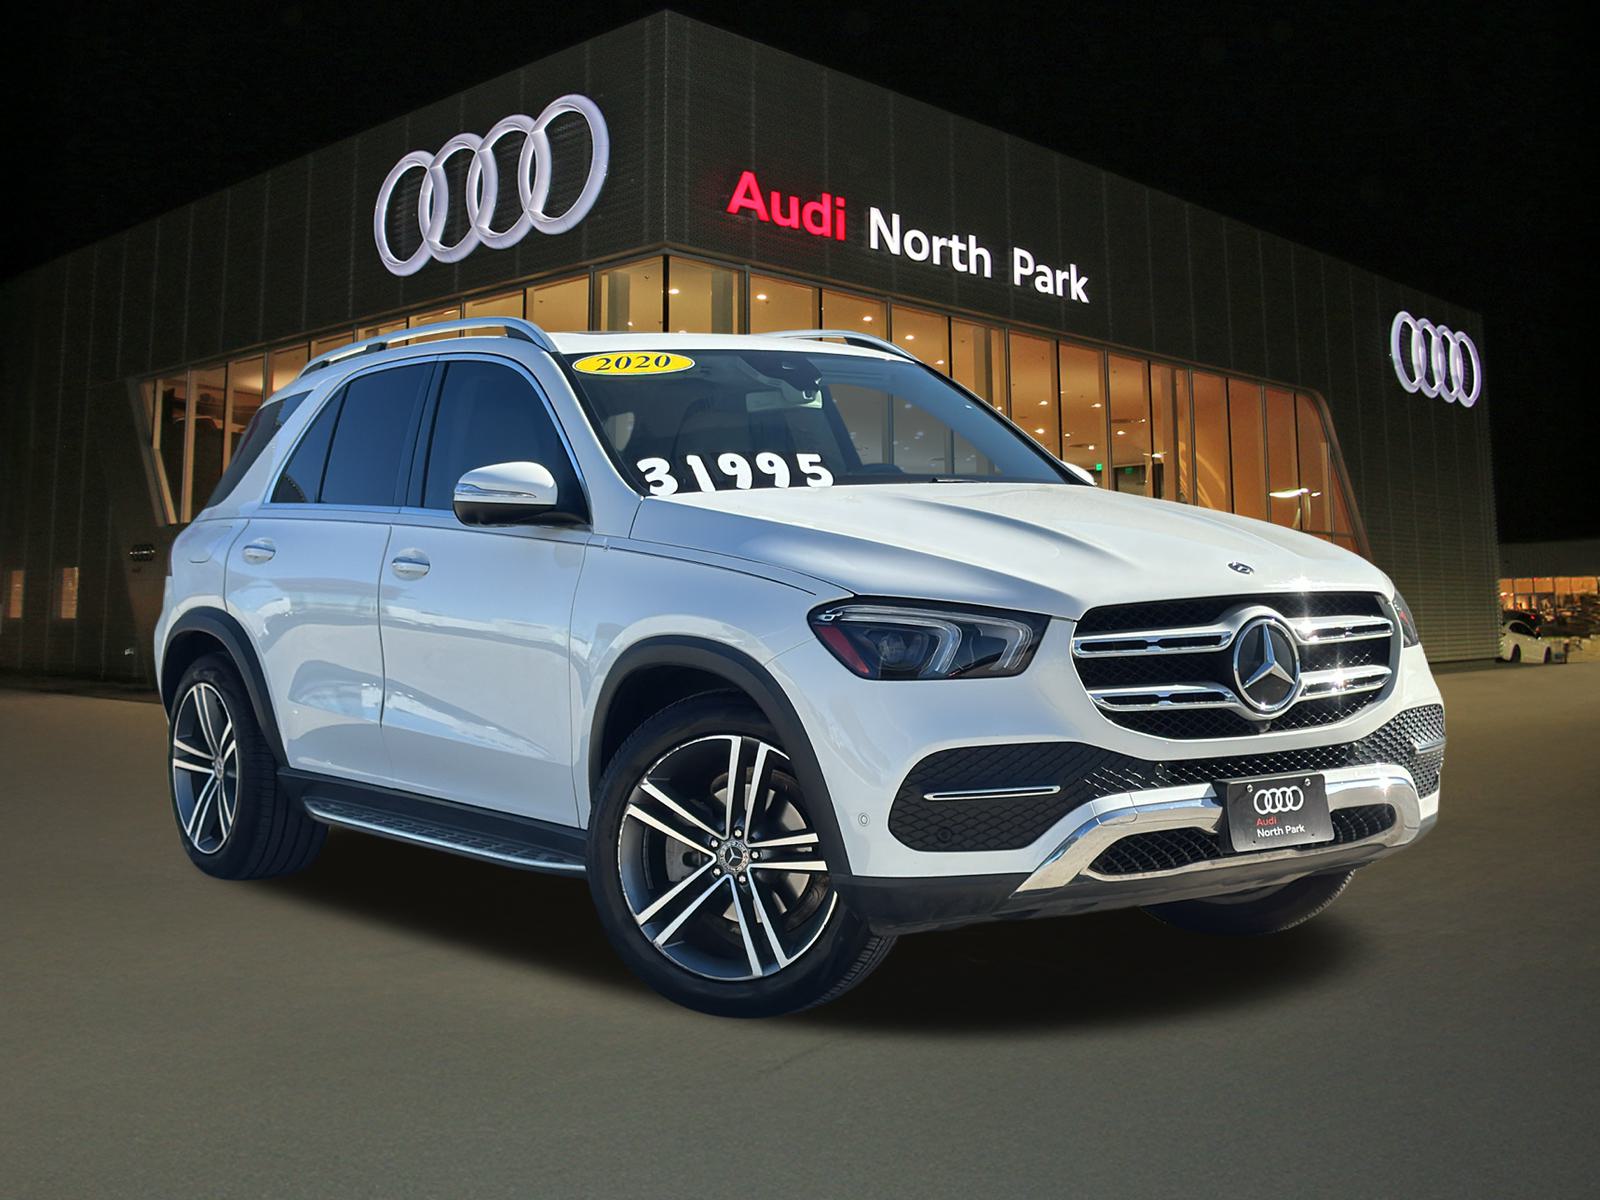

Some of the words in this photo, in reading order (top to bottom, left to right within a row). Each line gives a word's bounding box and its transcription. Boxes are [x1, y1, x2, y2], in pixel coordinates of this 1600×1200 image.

[726, 170, 846, 241] Audi
[868, 206, 992, 279] North
[1012, 246, 1090, 304] Park
[596, 354, 671, 371] 2020
[636, 451, 834, 497] 31995
[1256, 816, 1277, 827] Audi
[1257, 826, 1284, 838] North
[1285, 824, 1306, 835] Park
